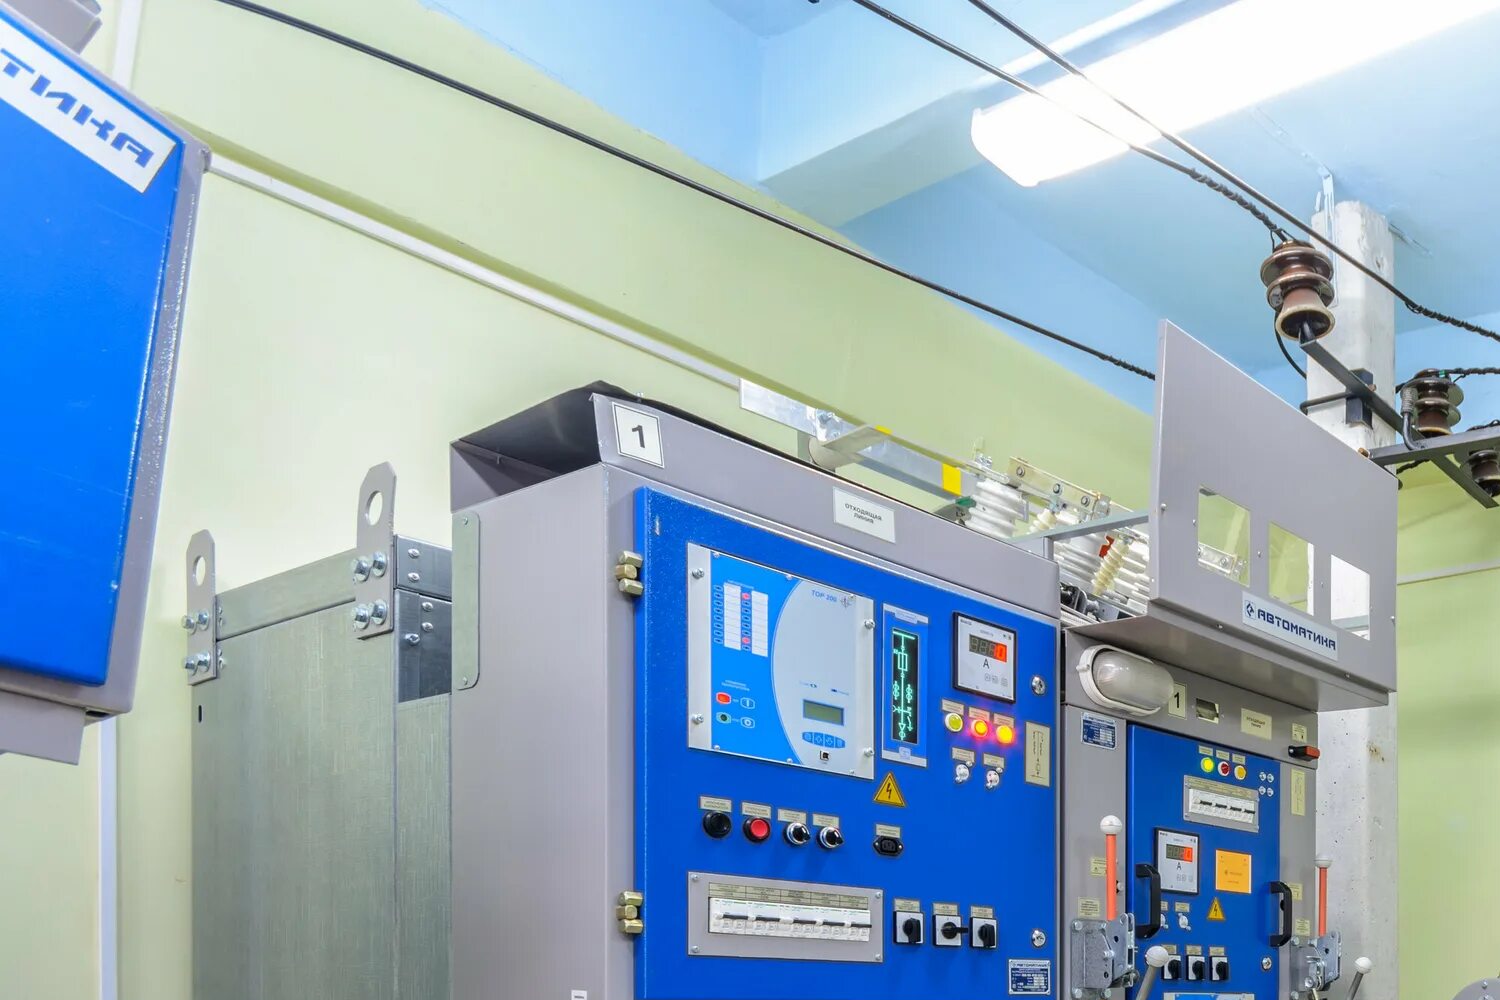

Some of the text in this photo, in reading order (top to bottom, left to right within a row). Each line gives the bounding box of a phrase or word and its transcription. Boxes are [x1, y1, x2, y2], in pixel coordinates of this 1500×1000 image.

[632, 424, 646, 449] 1
[845, 503, 882, 521] ОТХОДЯЩАЯ
[854, 512, 874, 524] ЛИНИЯ
[1257, 608, 1336, 651] АВТОМАТИКА
[1174, 692, 1180, 709] 1
